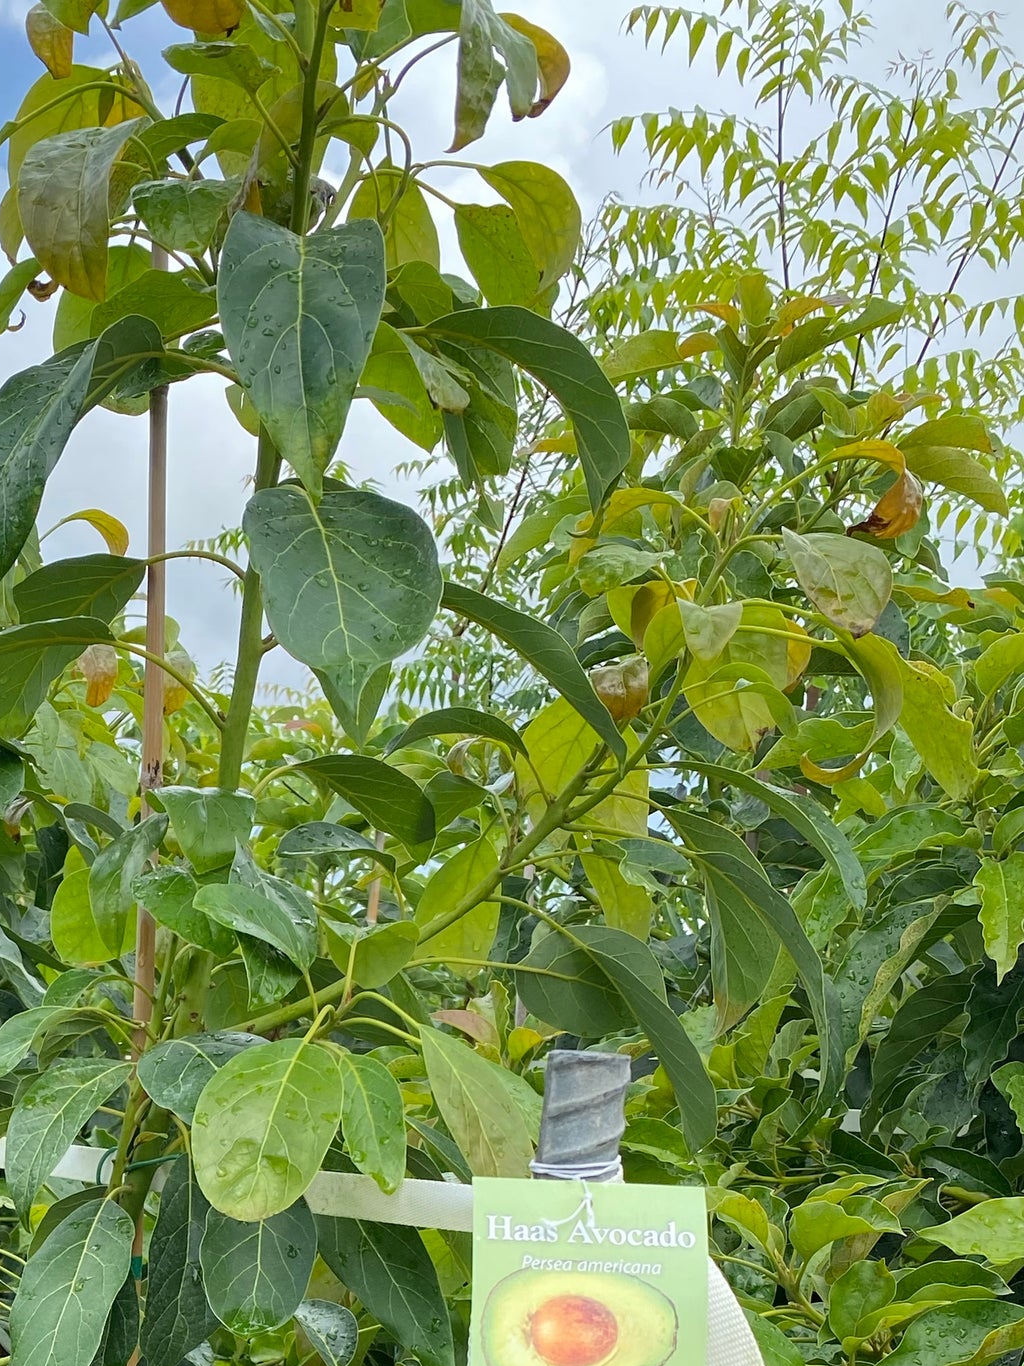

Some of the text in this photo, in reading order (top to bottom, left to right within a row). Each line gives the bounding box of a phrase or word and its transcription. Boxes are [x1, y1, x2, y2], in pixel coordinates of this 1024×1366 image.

[486, 1214, 696, 1248] Haas Avocado
[522, 1254, 662, 1275] Persea americana
